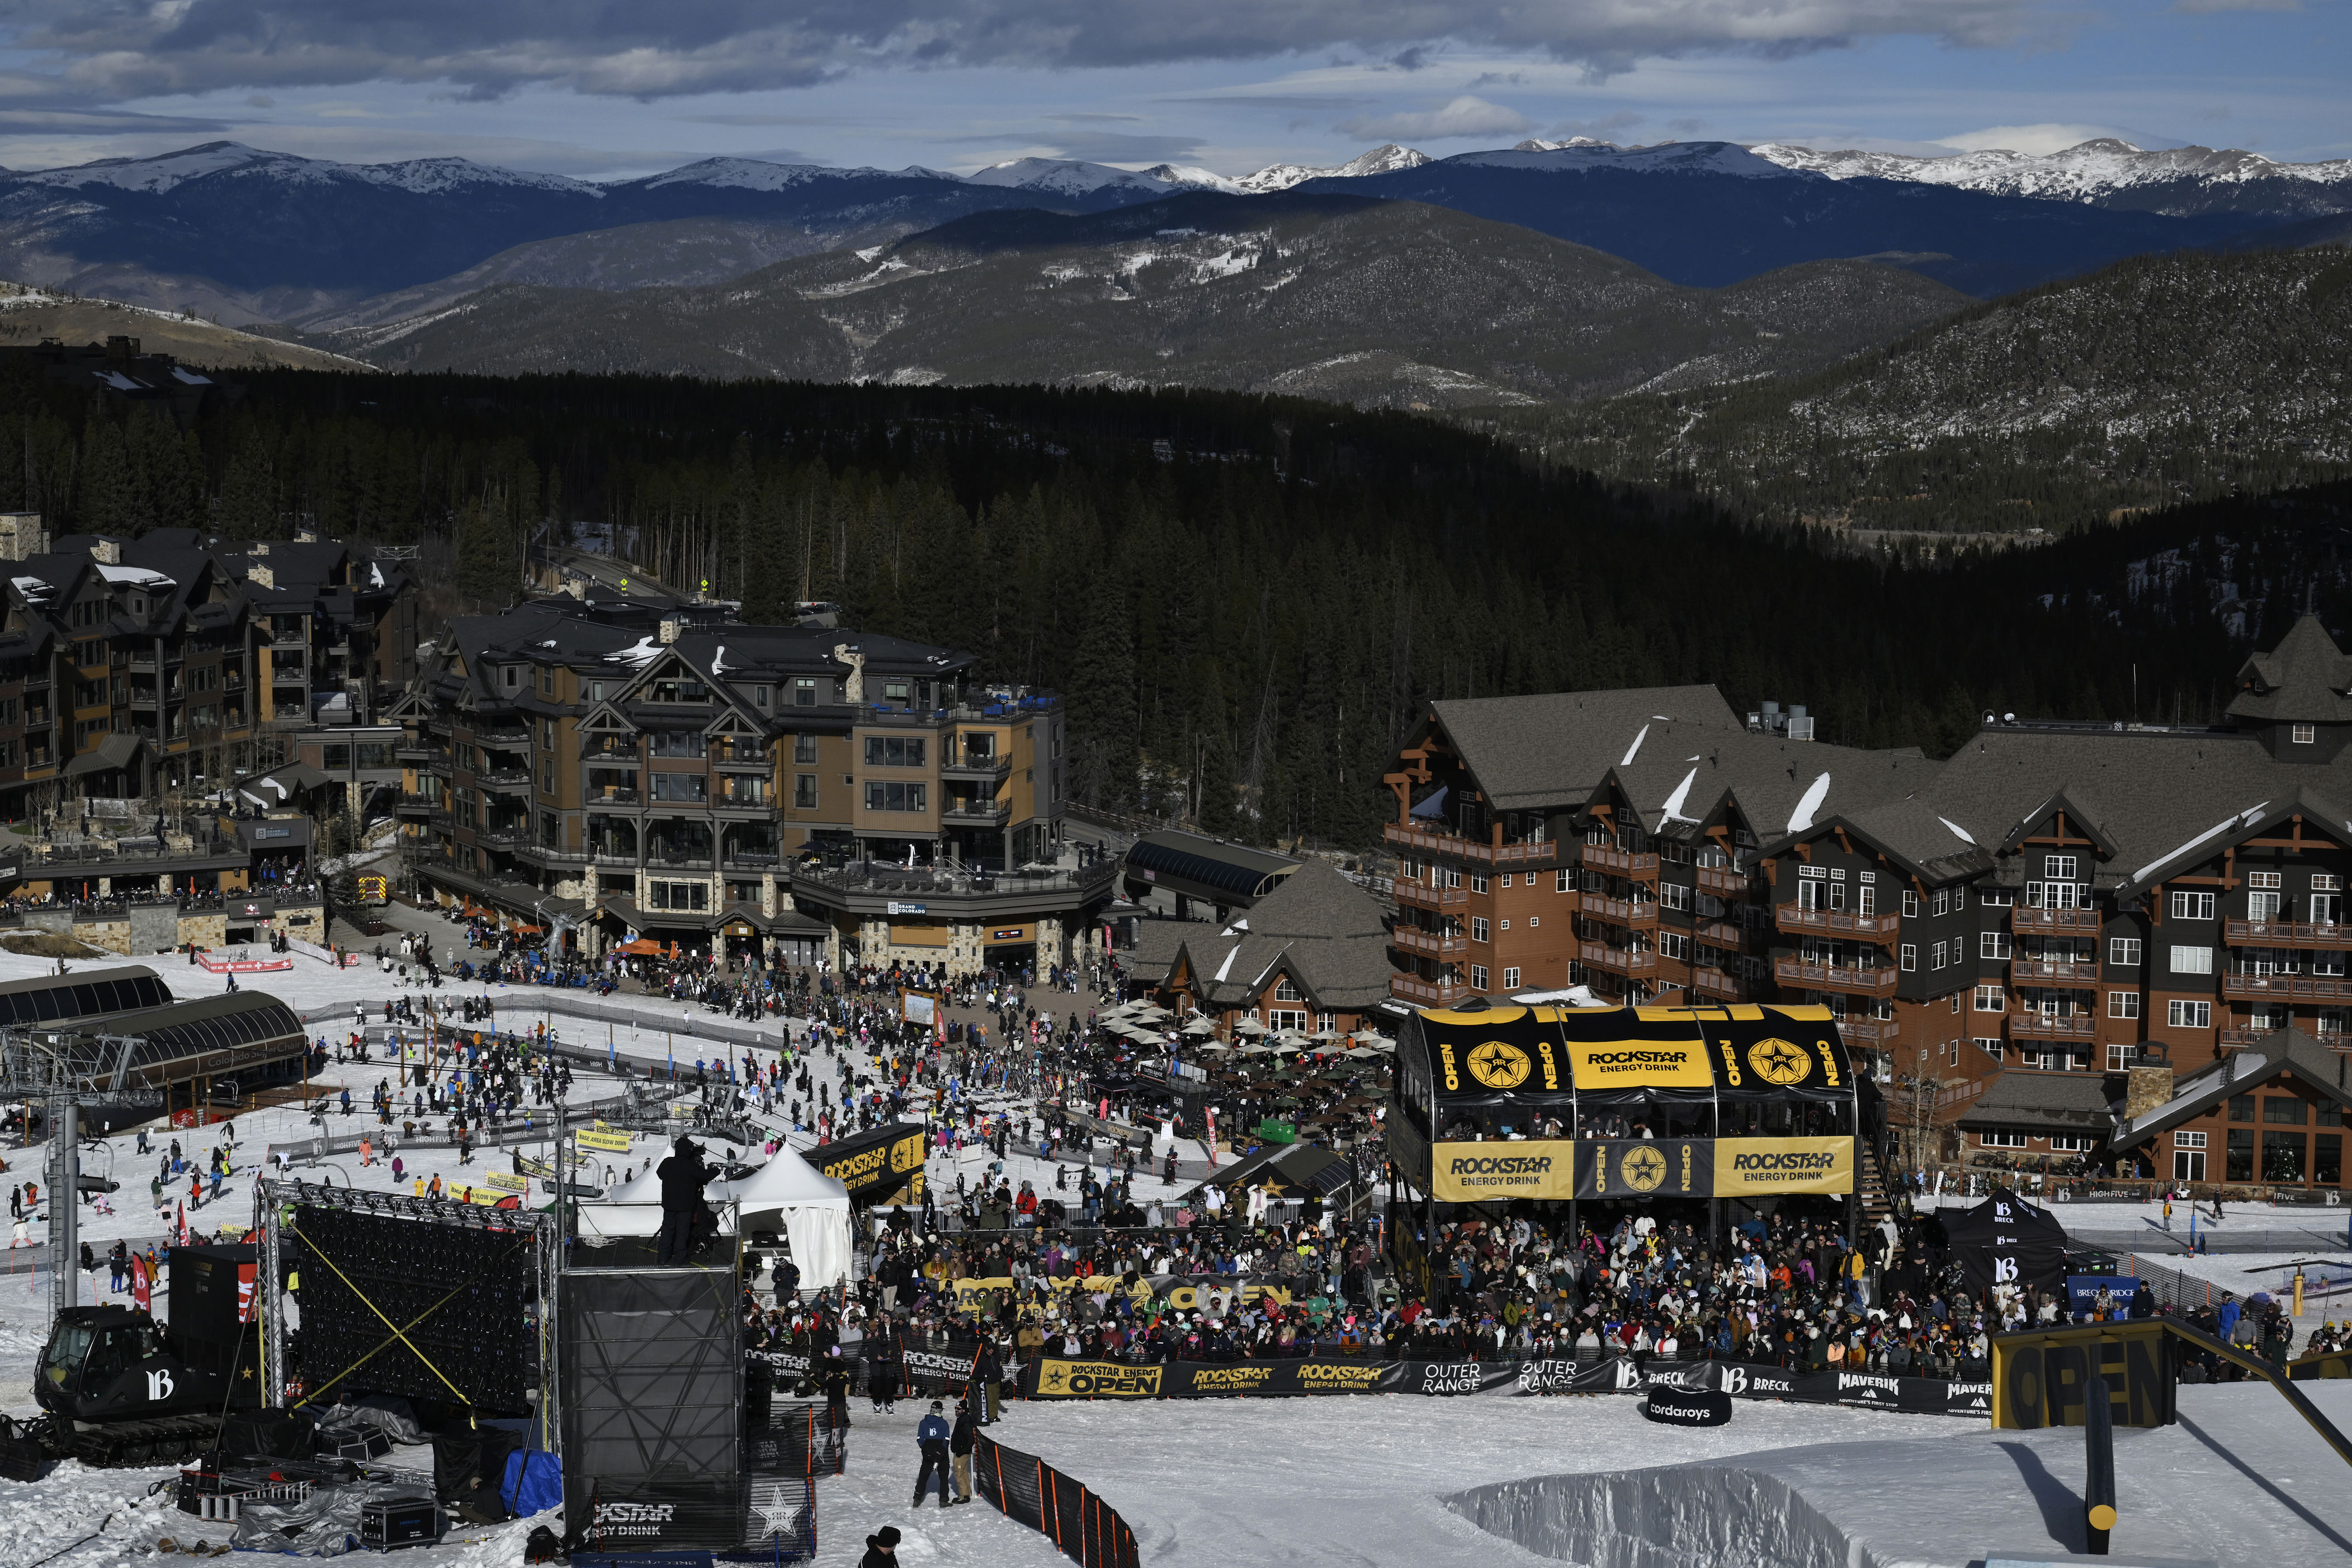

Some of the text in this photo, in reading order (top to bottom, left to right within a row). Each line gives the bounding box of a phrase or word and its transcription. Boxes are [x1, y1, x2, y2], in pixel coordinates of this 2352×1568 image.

[208, 1051, 250, 1068] Colorado
[1538, 1042, 1557, 1089] OPEN
[1588, 1051, 1688, 1065] ROCKSTAR
[1719, 1040, 1741, 1087] OPEN
[1816, 1040, 1839, 1086] OPEN
[1439, 1043, 1458, 1090] OPEN
[1600, 1063, 1643, 1073] ENERGY
[502, 1130, 528, 1141] HIGH FIVE
[1107, 1125, 1134, 1139] ROCKSTAR
[334, 1140, 361, 1150] HIGH FIVE
[824, 1146, 886, 1179] ROCKSTAR
[1451, 1156, 1552, 1174] ROCKSTAR
[1597, 1146, 1606, 1193] OPEN
[1682, 1145, 1690, 1191] OPEN
[1734, 1153, 1834, 1170] ROCKSTAR
[488, 1178, 525, 1190] SLOW DOWN
[857, 1170, 879, 1187] DRINK
[1461, 1176, 1541, 1186] ENERGY DRINK
[1744, 1172, 1823, 1182] ENERGY DRINK
[451, 1187, 463, 1196] BASE
[2277, 1192, 2295, 1201] FIVE
[1358, 1206, 1367, 1220] Five
[1170, 1285, 1291, 1309] OEN
[745, 1348, 811, 1369] OCKSTAR
[903, 1350, 974, 1372] ROCKSTA
[775, 1368, 804, 1377] DRINK
[912, 1367, 970, 1381] ENERGY DRIN
[1071, 1365, 1158, 1377] ROCKSTAR ENERGY
[1193, 1367, 1273, 1384] ROCKSTAR
[1297, 1364, 1382, 1381] ROCKSTAR
[1425, 1363, 1480, 1378] OUTER
[1520, 1359, 1577, 1376] OUTER
[1069, 1375, 1158, 1393] OPEN
[1340, 1381, 1369, 1389] DRINK
[1421, 1378, 1481, 1393] RANGE
[1649, 1372, 1685, 1386] BRECK
[1753, 1377, 1789, 1391] BRECK
[1839, 1373, 1900, 1396] MAVERIK
[2010, 1338, 2163, 1430] OPEN
[1947, 1383, 1992, 1400] MAVER
[1650, 1404, 1710, 1420] cordaroys
[618, 1526, 661, 1536] DRINK
